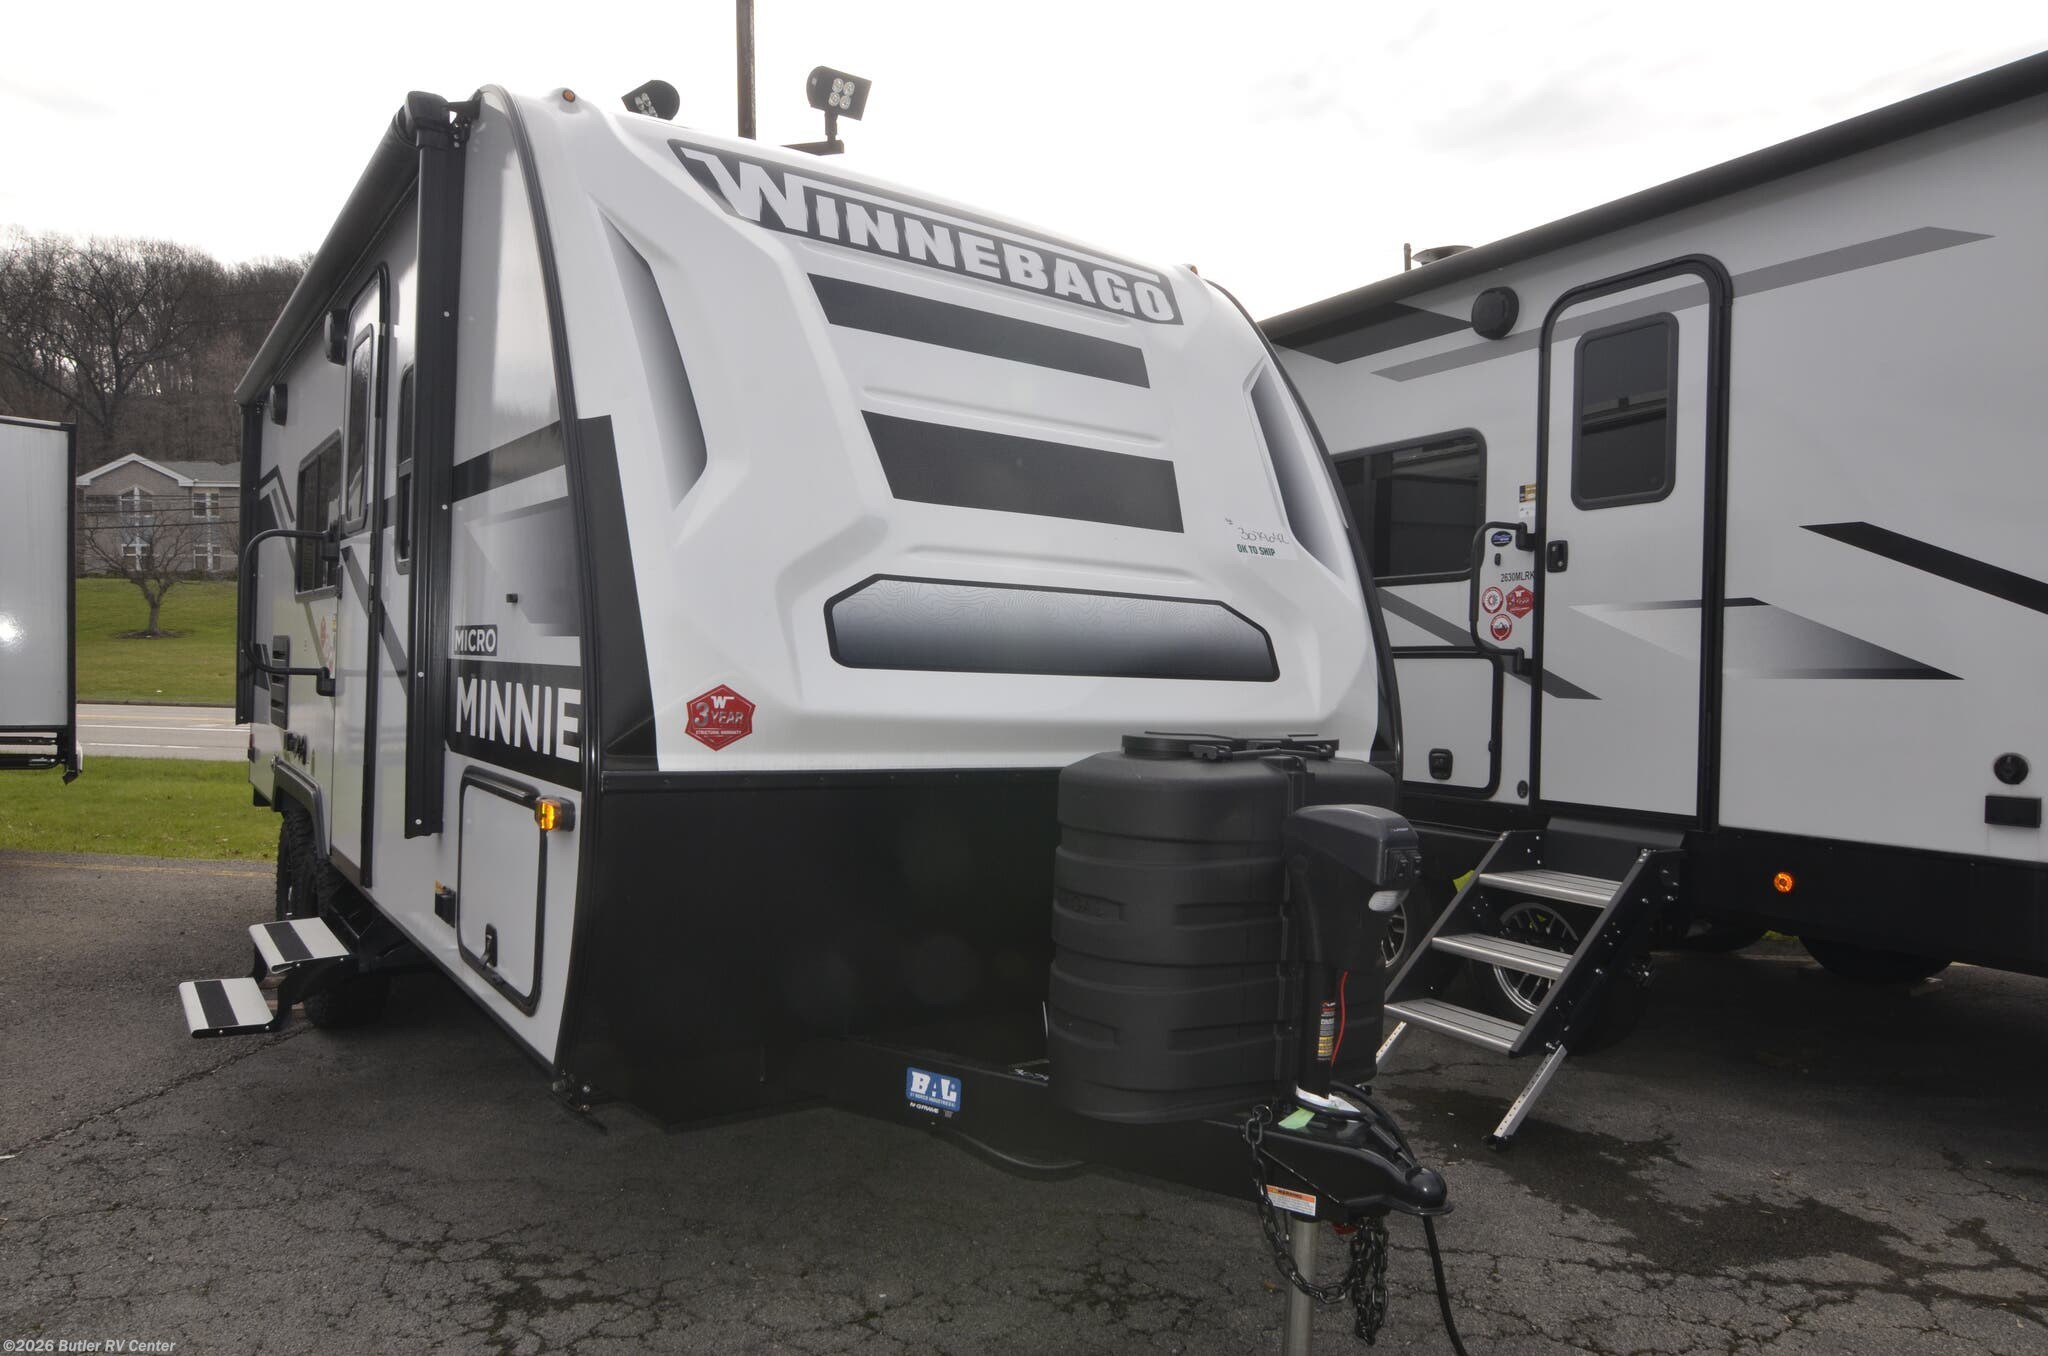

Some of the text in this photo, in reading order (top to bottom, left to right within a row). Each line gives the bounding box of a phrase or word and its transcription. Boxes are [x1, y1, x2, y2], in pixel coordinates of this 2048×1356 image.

[680, 147, 1175, 322] WINNEBAGO
[1236, 543, 1276, 556] OK TO SHIP
[454, 628, 497, 652] MICRO
[455, 676, 582, 763] MINNIE
[694, 701, 744, 727] 3 YEAR
